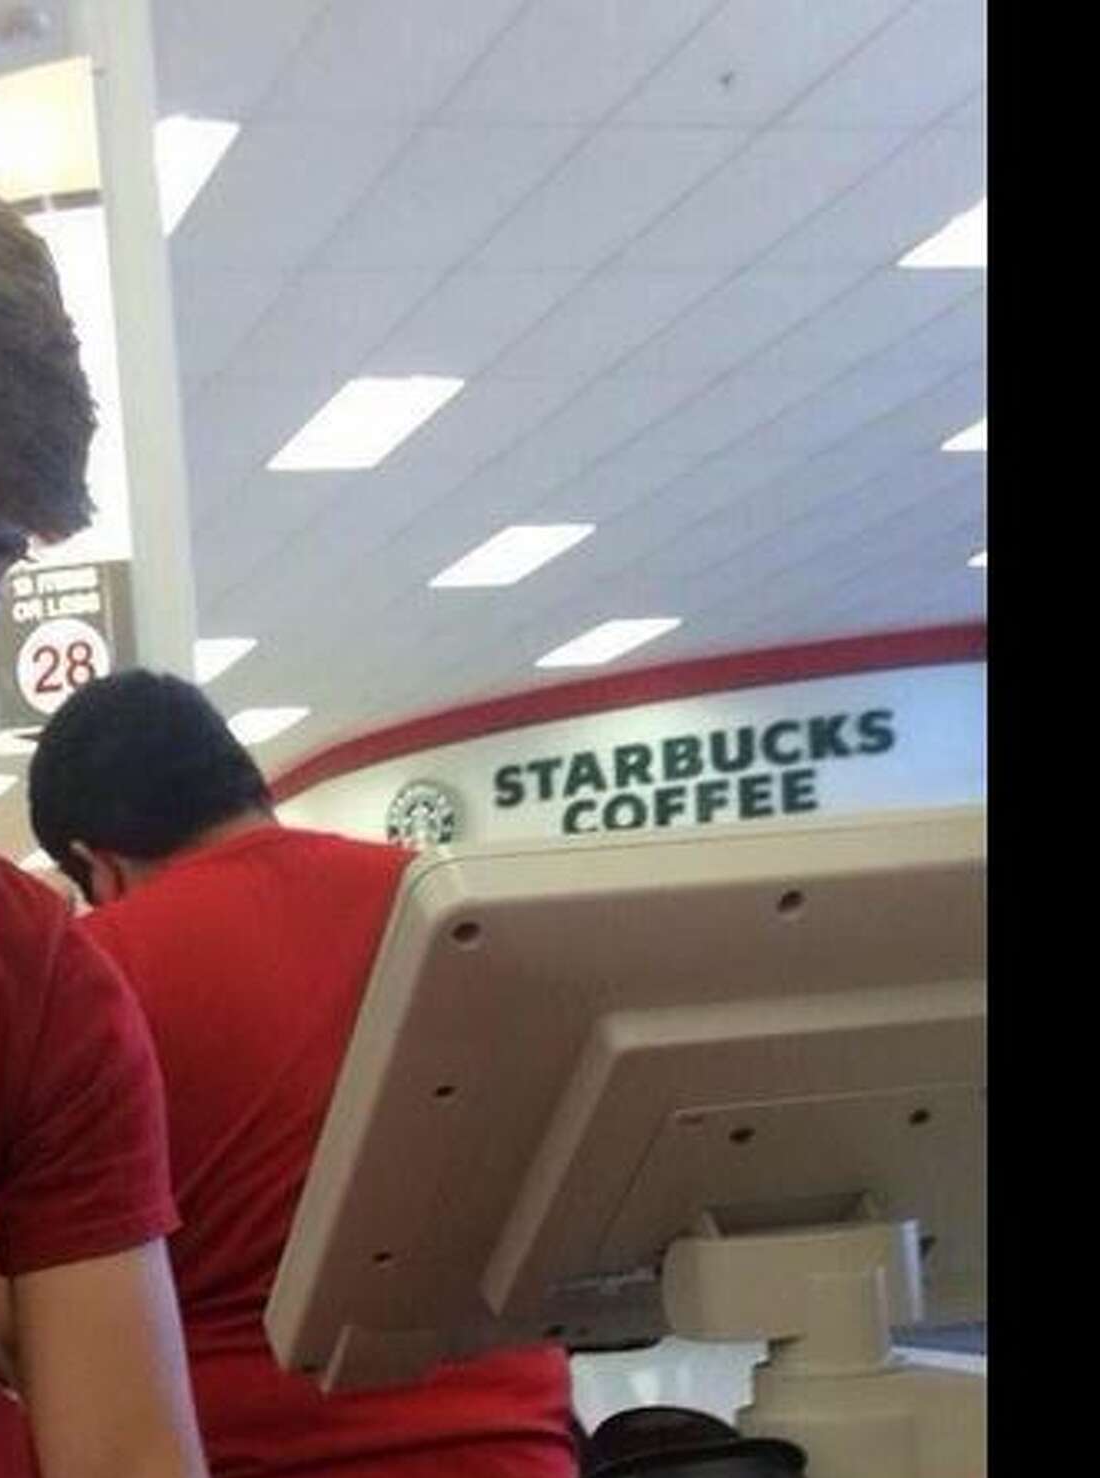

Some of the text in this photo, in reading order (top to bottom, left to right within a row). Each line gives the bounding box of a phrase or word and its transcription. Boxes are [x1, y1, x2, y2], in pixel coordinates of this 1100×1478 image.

[31, 641, 96, 694] 28
[492, 708, 897, 809] STARBUCKS
[560, 767, 820, 836] COFFEE
